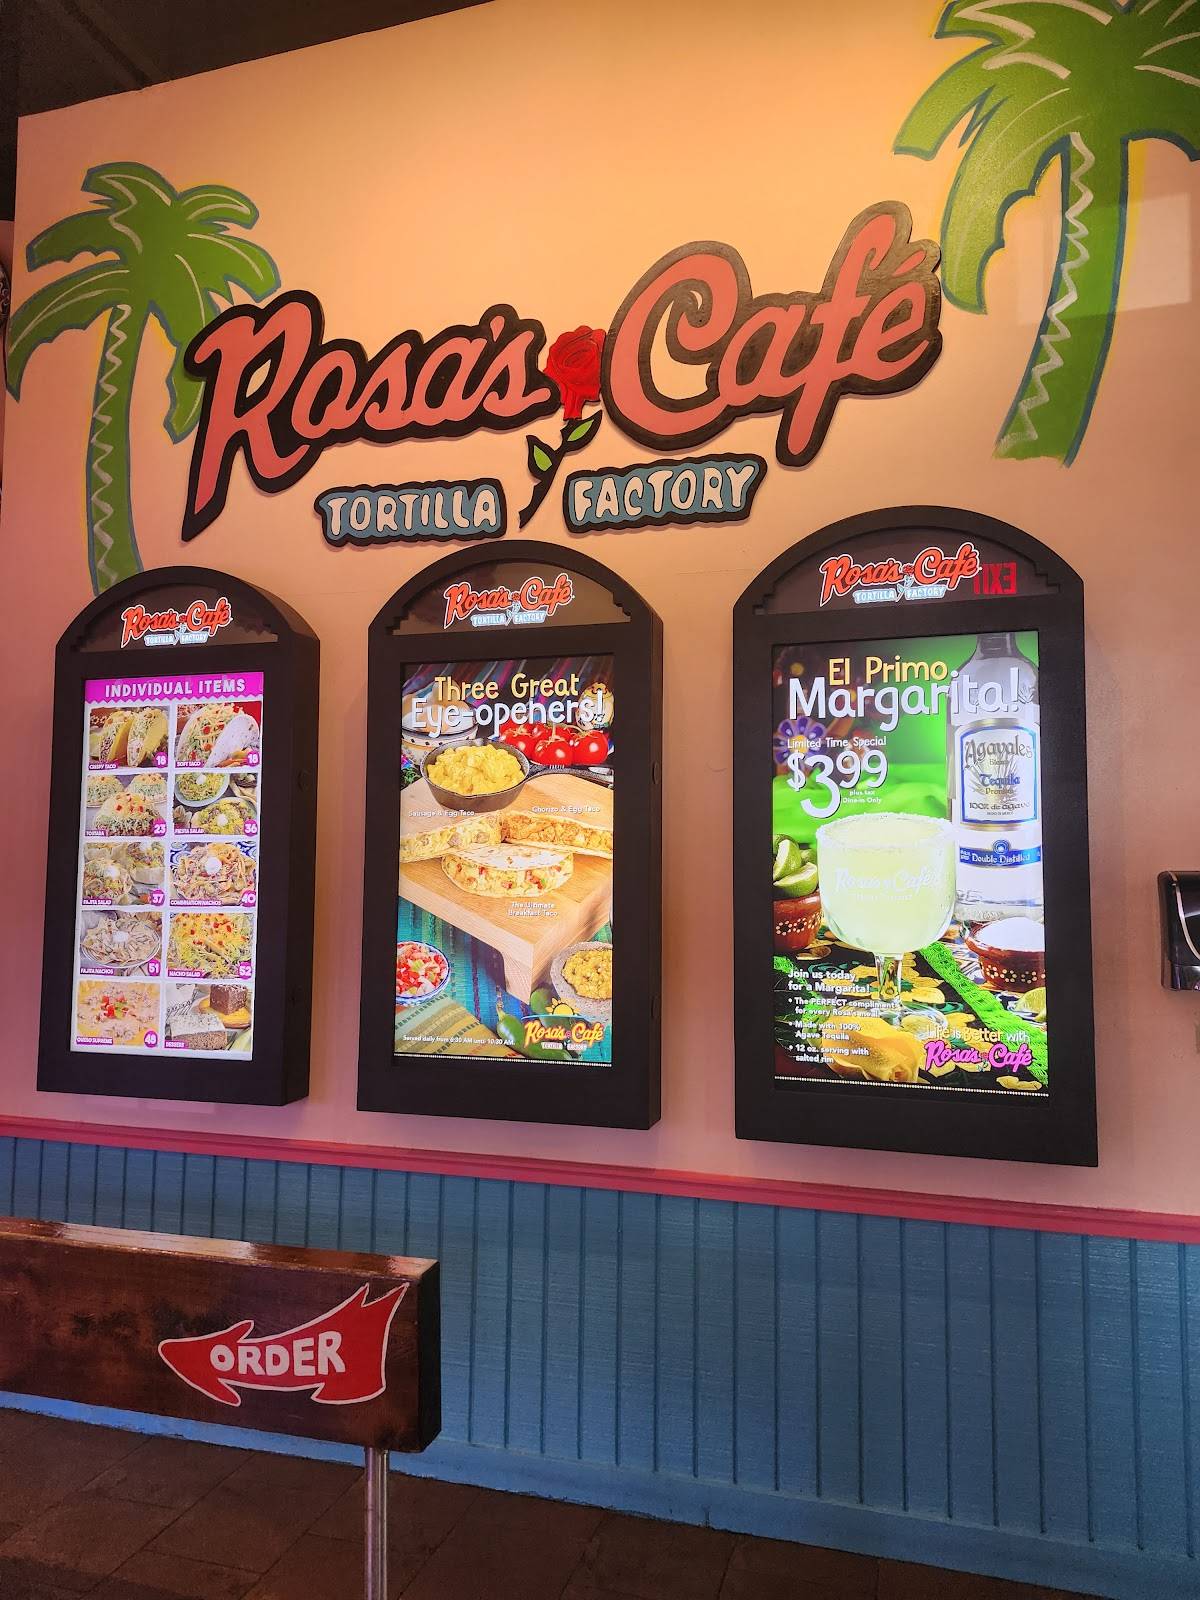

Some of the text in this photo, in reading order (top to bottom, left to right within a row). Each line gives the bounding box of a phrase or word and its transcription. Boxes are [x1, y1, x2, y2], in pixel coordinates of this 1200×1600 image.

[187, 208, 937, 530] Rosa's Café
[326, 464, 753, 537] TORTILLA FACTORY
[820, 543, 980, 606] Rosa's Café
[444, 573, 573, 628] Rosa's Café
[855, 586, 947, 602] TORTILLA FACTORY
[121, 597, 232, 648] Rosa's Café
[828, 655, 948, 686] El Primo
[105, 678, 246, 698] INDIVIDUAL ITEMS
[434, 672, 580, 701] Three Great
[788, 666, 1020, 732] Margarita!
[410, 689, 605, 740] Eye-openers!
[787, 735, 887, 749] Limited Time Special
[964, 734, 1033, 769] Agavales
[153, 823, 166, 834] 23
[243, 823, 257, 834] 36
[972, 852, 998, 863] Double
[151, 893, 163, 903] 37
[241, 893, 256, 904] 40
[148, 962, 159, 973] 51
[238, 965, 252, 976] 52
[787, 968, 810, 979] Join
[811, 970, 824, 979] us
[787, 980, 804, 990] for
[814, 981, 870, 995] Margarita!
[794, 997, 808, 1005] The
[809, 996, 847, 1006] PERFECT
[795, 1020, 817, 1029] Made
[819, 1021, 836, 1029] with
[524, 1020, 604, 1049] Rosa's Café
[795, 1030, 849, 1041] Agave Tequila
[962, 1026, 1003, 1043] Better
[1006, 1029, 1030, 1044] with
[795, 1053, 834, 1064] salted rim
[820, 1047, 850, 1056] serving
[851, 1047, 869, 1056] with
[924, 1039, 1033, 1073] Rosa's Café
[209, 1330, 346, 1378] ORDER
